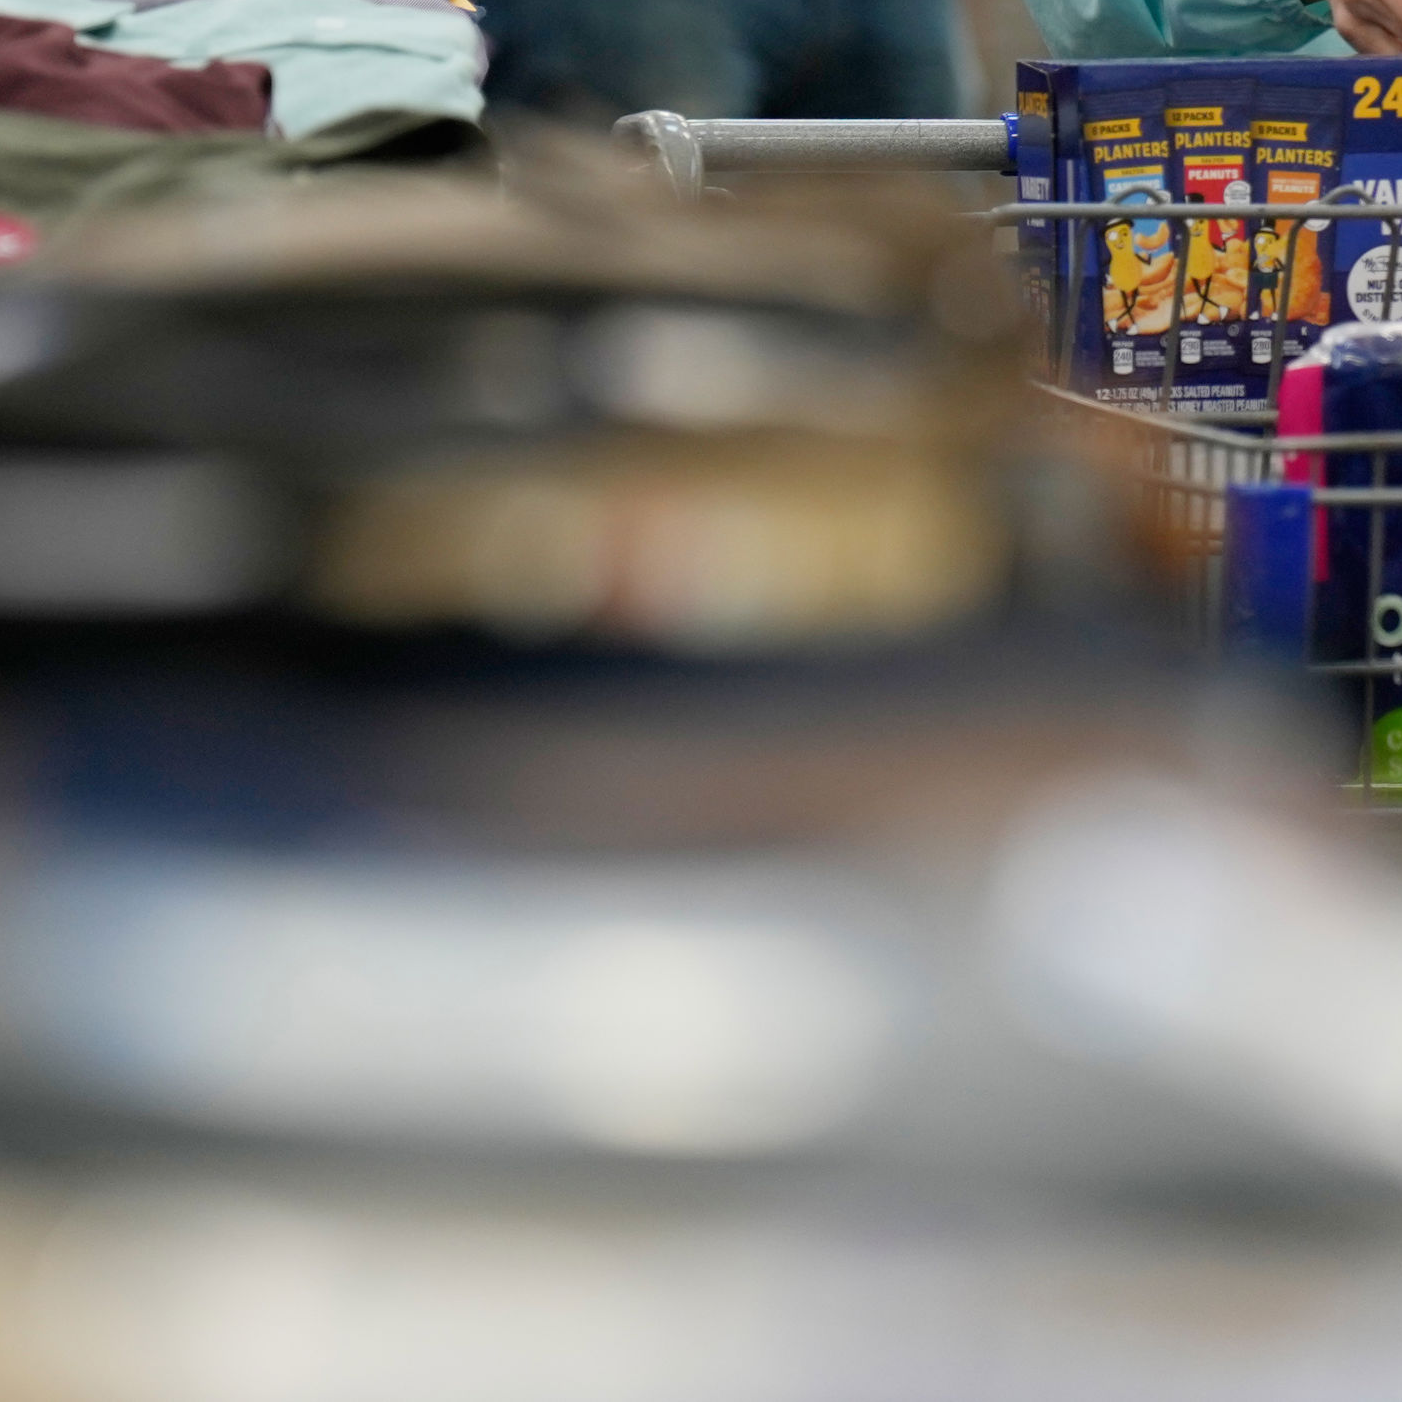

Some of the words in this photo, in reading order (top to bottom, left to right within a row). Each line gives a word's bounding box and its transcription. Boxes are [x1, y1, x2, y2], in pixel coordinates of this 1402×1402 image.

[1172, 112, 1182, 121] 12
[1184, 111, 1215, 121] PACKS
[1100, 124, 1131, 134] PACKS
[1266, 126, 1297, 136] PACKS
[1174, 132, 1252, 149] PLANTERS
[1093, 140, 1169, 164] PLANTERS
[1256, 147, 1333, 168] PLANTERS
[1188, 169, 1239, 181] PEANUTS
[1272, 184, 1315, 194] PEANUTS
[1367, 279, 1395, 290] NUT
[1211, 385, 1245, 397] PEANUTS
